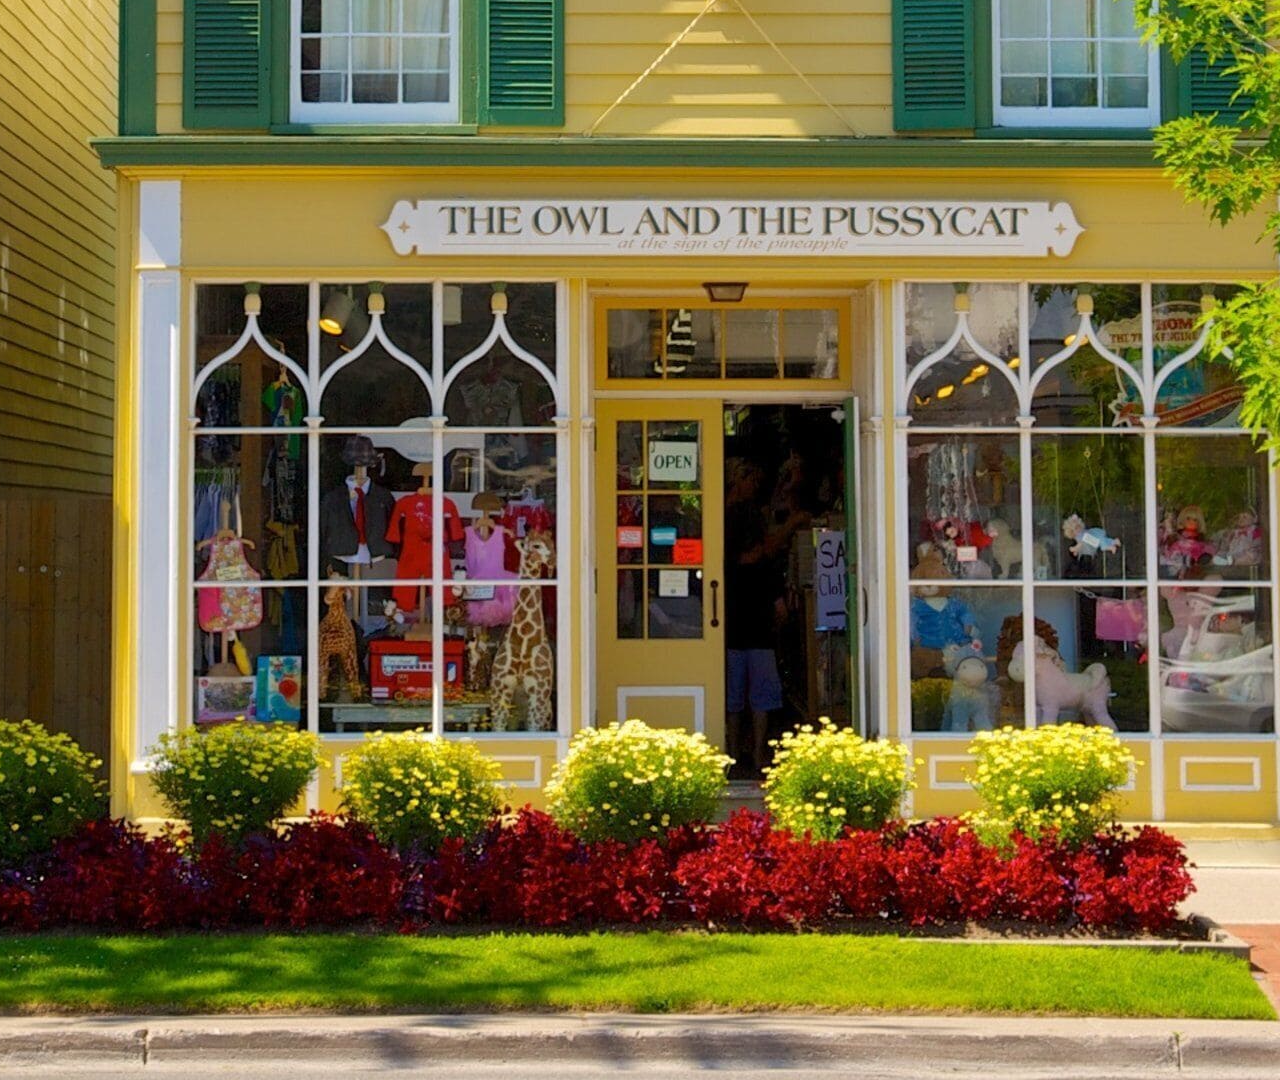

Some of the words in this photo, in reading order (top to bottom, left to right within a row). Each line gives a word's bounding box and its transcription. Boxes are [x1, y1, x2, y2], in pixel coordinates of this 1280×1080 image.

[439, 206, 522, 236] THE
[532, 206, 624, 236] OWL
[633, 206, 721, 236] AND
[729, 206, 813, 236] THE
[822, 206, 1028, 237] PUSSYCAT
[617, 238, 634, 250] at
[641, 236, 668, 250] the
[673, 237, 708, 253] sign
[713, 236, 731, 252] of
[736, 236, 763, 250] the
[767, 236, 849, 252] pineapple
[654, 454, 692, 469] OPEN
